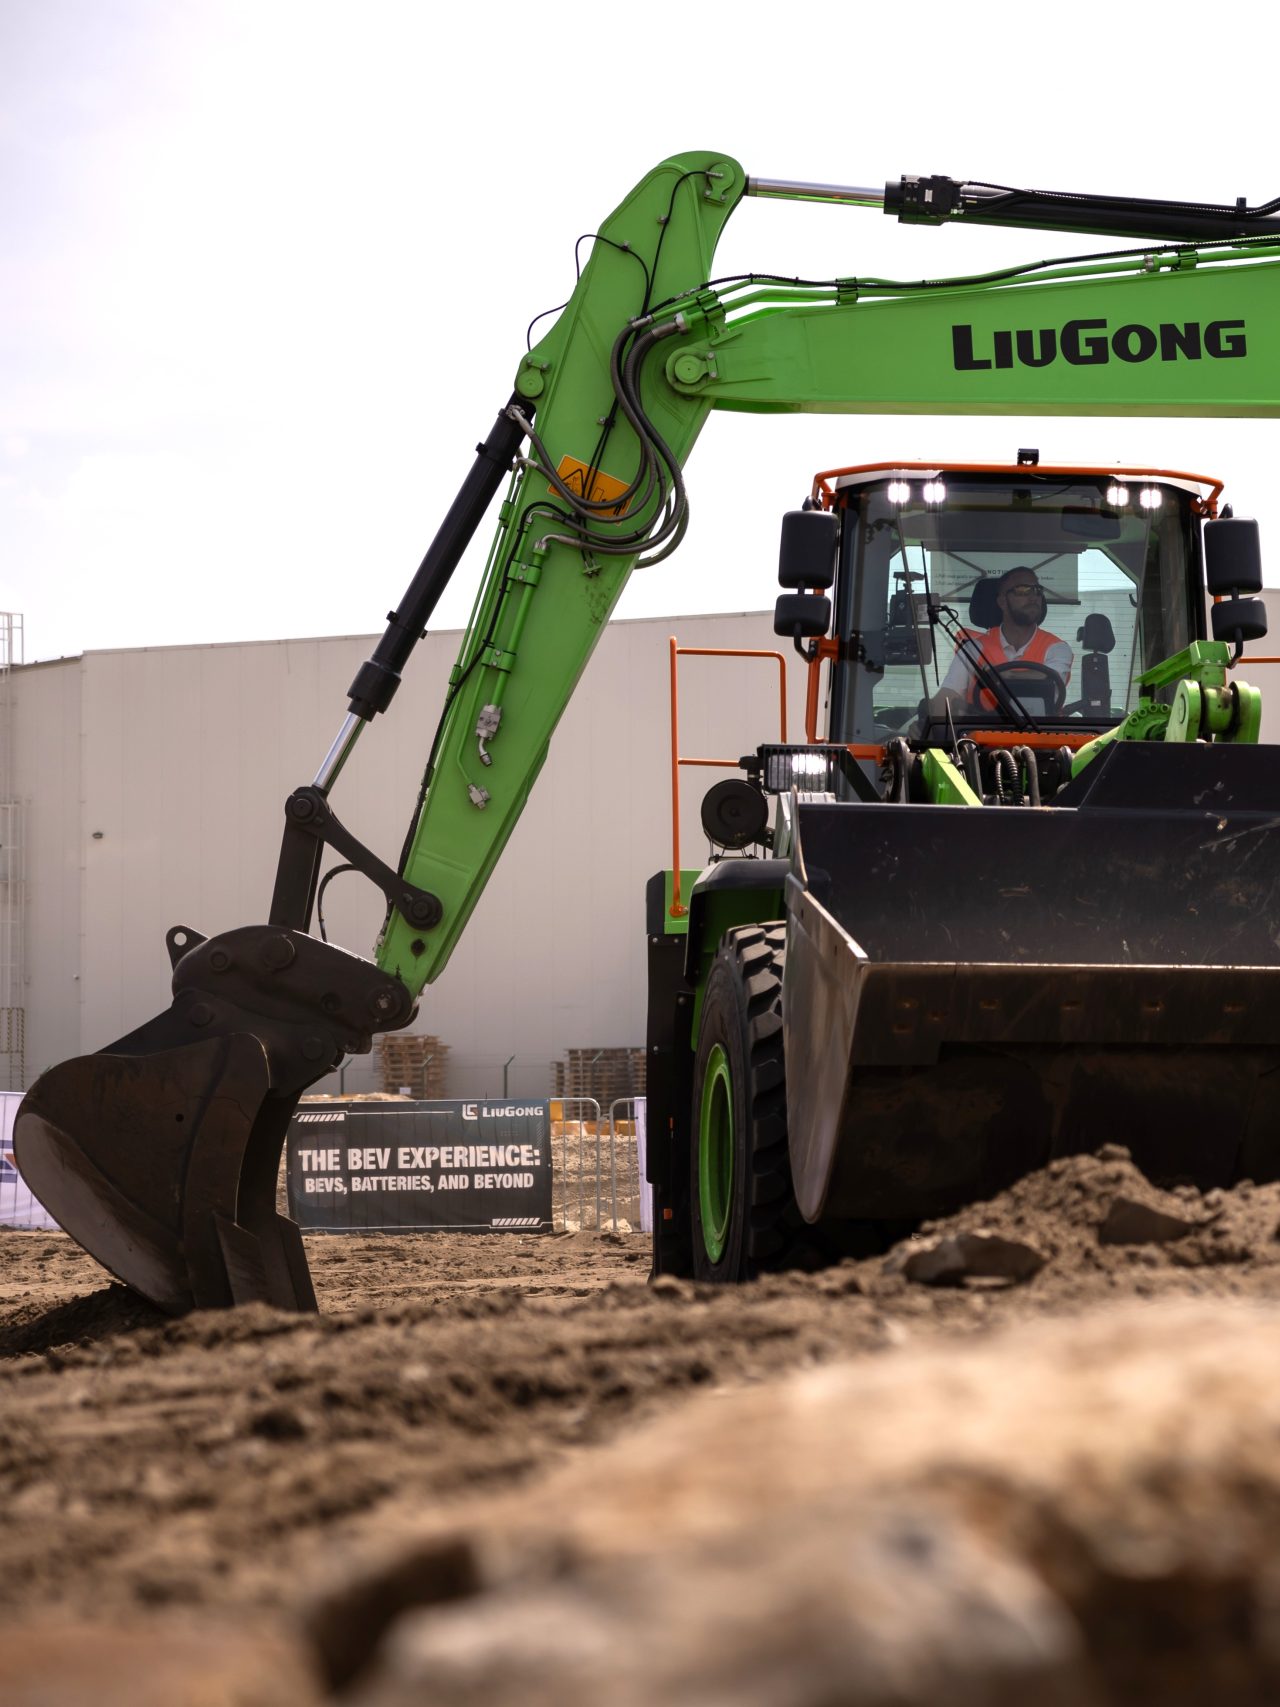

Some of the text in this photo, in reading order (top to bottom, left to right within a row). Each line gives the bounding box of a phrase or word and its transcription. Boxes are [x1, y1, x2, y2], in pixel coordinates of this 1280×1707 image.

[298, 1144, 541, 1172] THE BEV EXPERIENCE:
[305, 1173, 534, 1195] BEVS, BATTERIES, AND BEYOND
